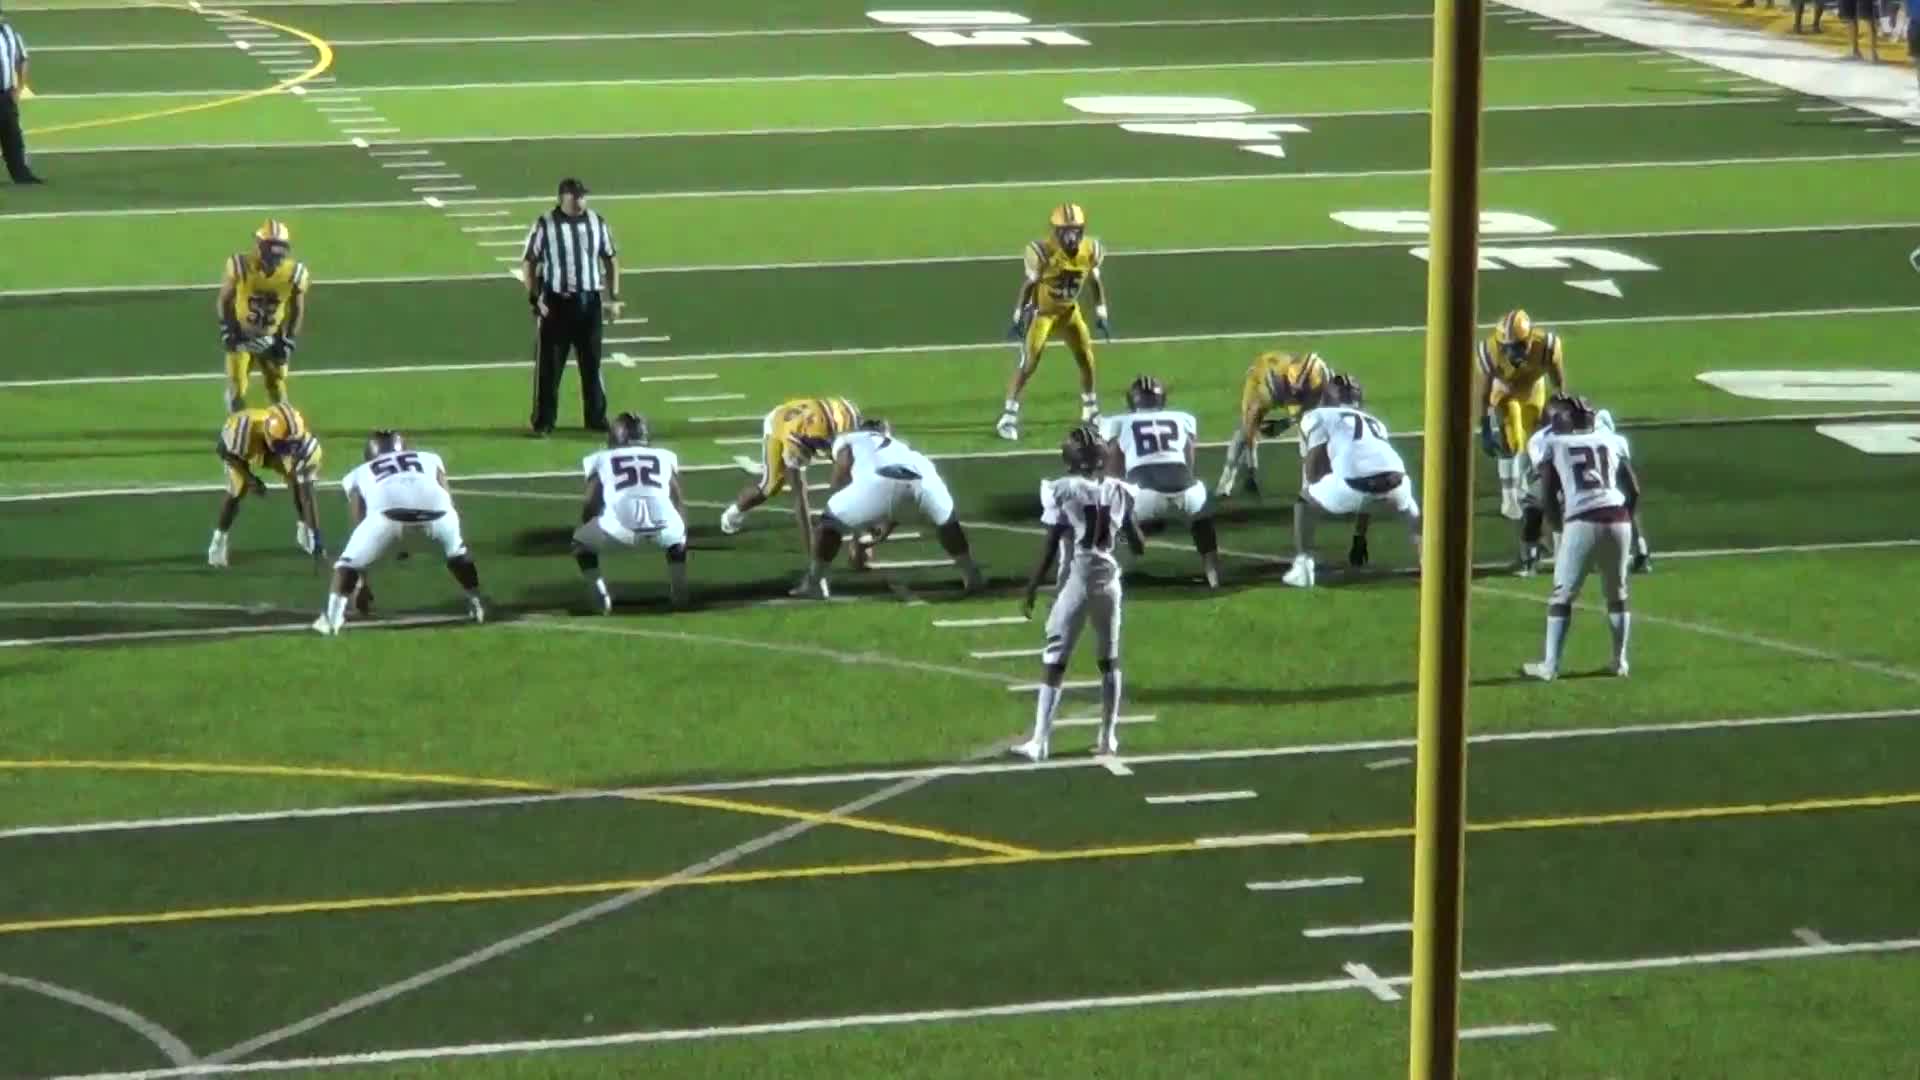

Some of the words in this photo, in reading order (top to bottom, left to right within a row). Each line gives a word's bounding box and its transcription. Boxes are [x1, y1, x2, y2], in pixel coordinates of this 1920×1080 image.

[1132, 419, 1181, 457] 62
[369, 452, 424, 483] 56
[610, 455, 663, 492] 52
[1567, 443, 1611, 491] 21
